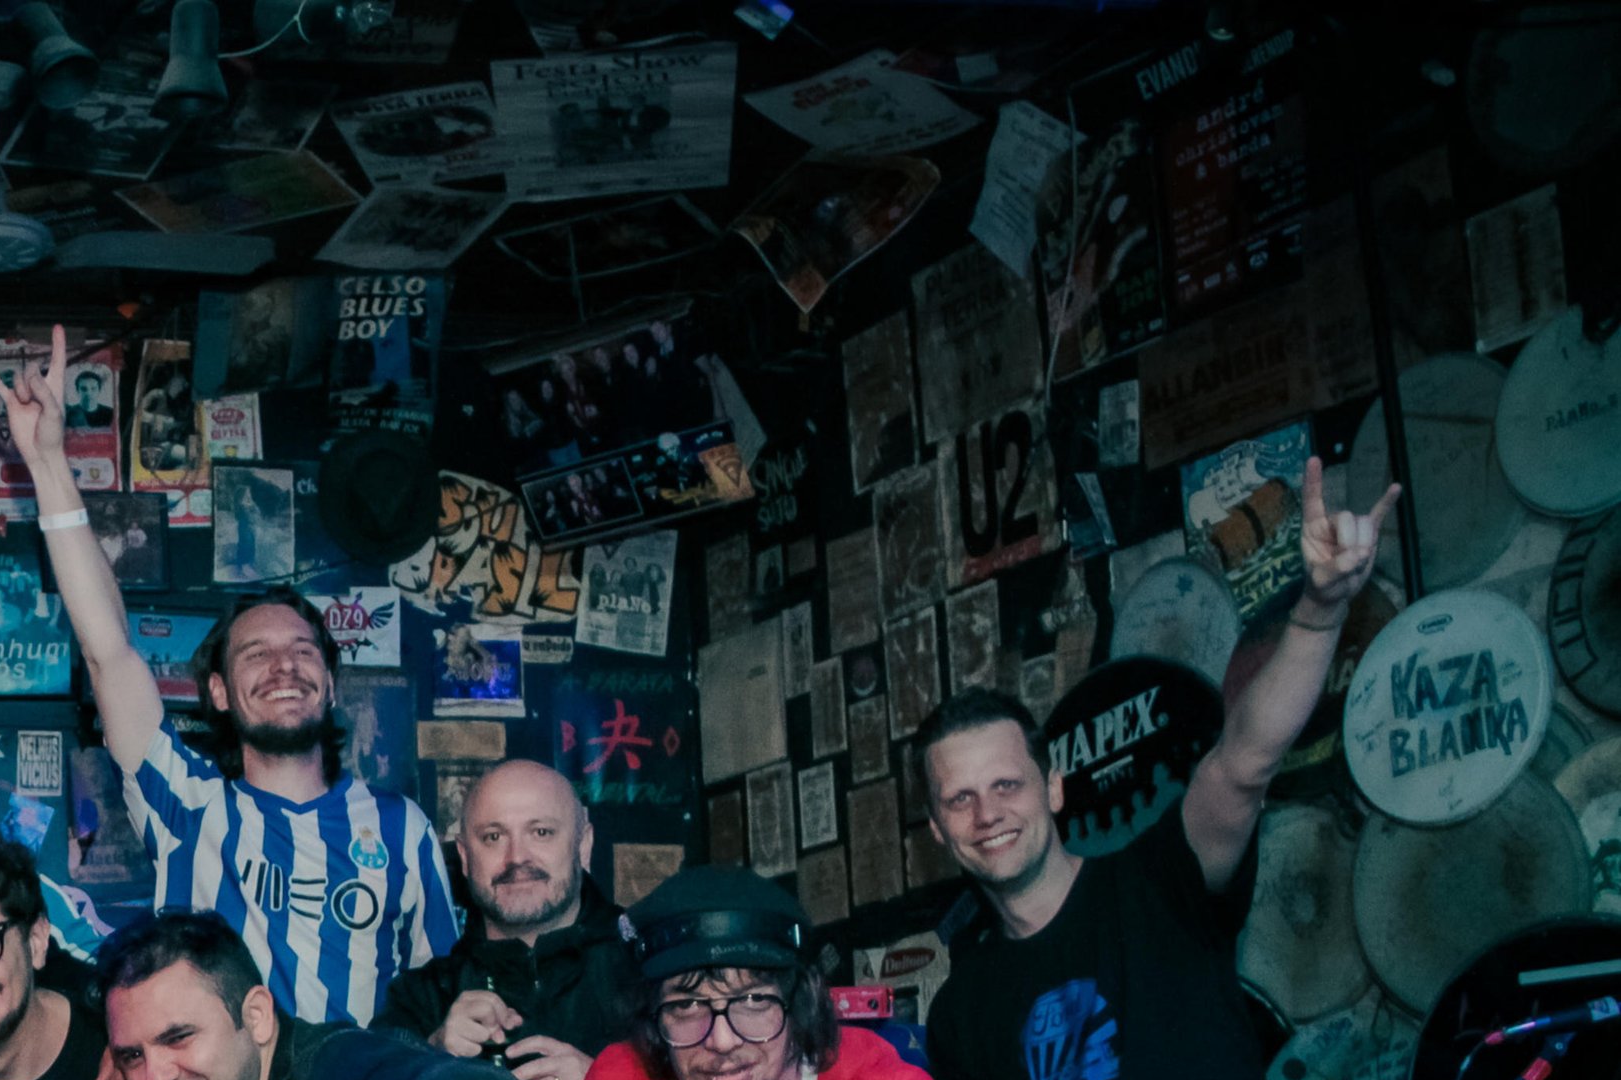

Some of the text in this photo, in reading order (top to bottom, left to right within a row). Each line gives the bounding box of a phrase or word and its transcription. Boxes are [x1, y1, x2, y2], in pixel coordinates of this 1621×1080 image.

[338, 275, 427, 297] CELSO
[338, 297, 426, 318] BLUES
[338, 318, 396, 340] BOY
[957, 410, 1038, 557] U2
[329, 607, 363, 629] DZ9
[1390, 648, 1500, 719] KAZA
[1388, 697, 1529, 777] BLANKA
